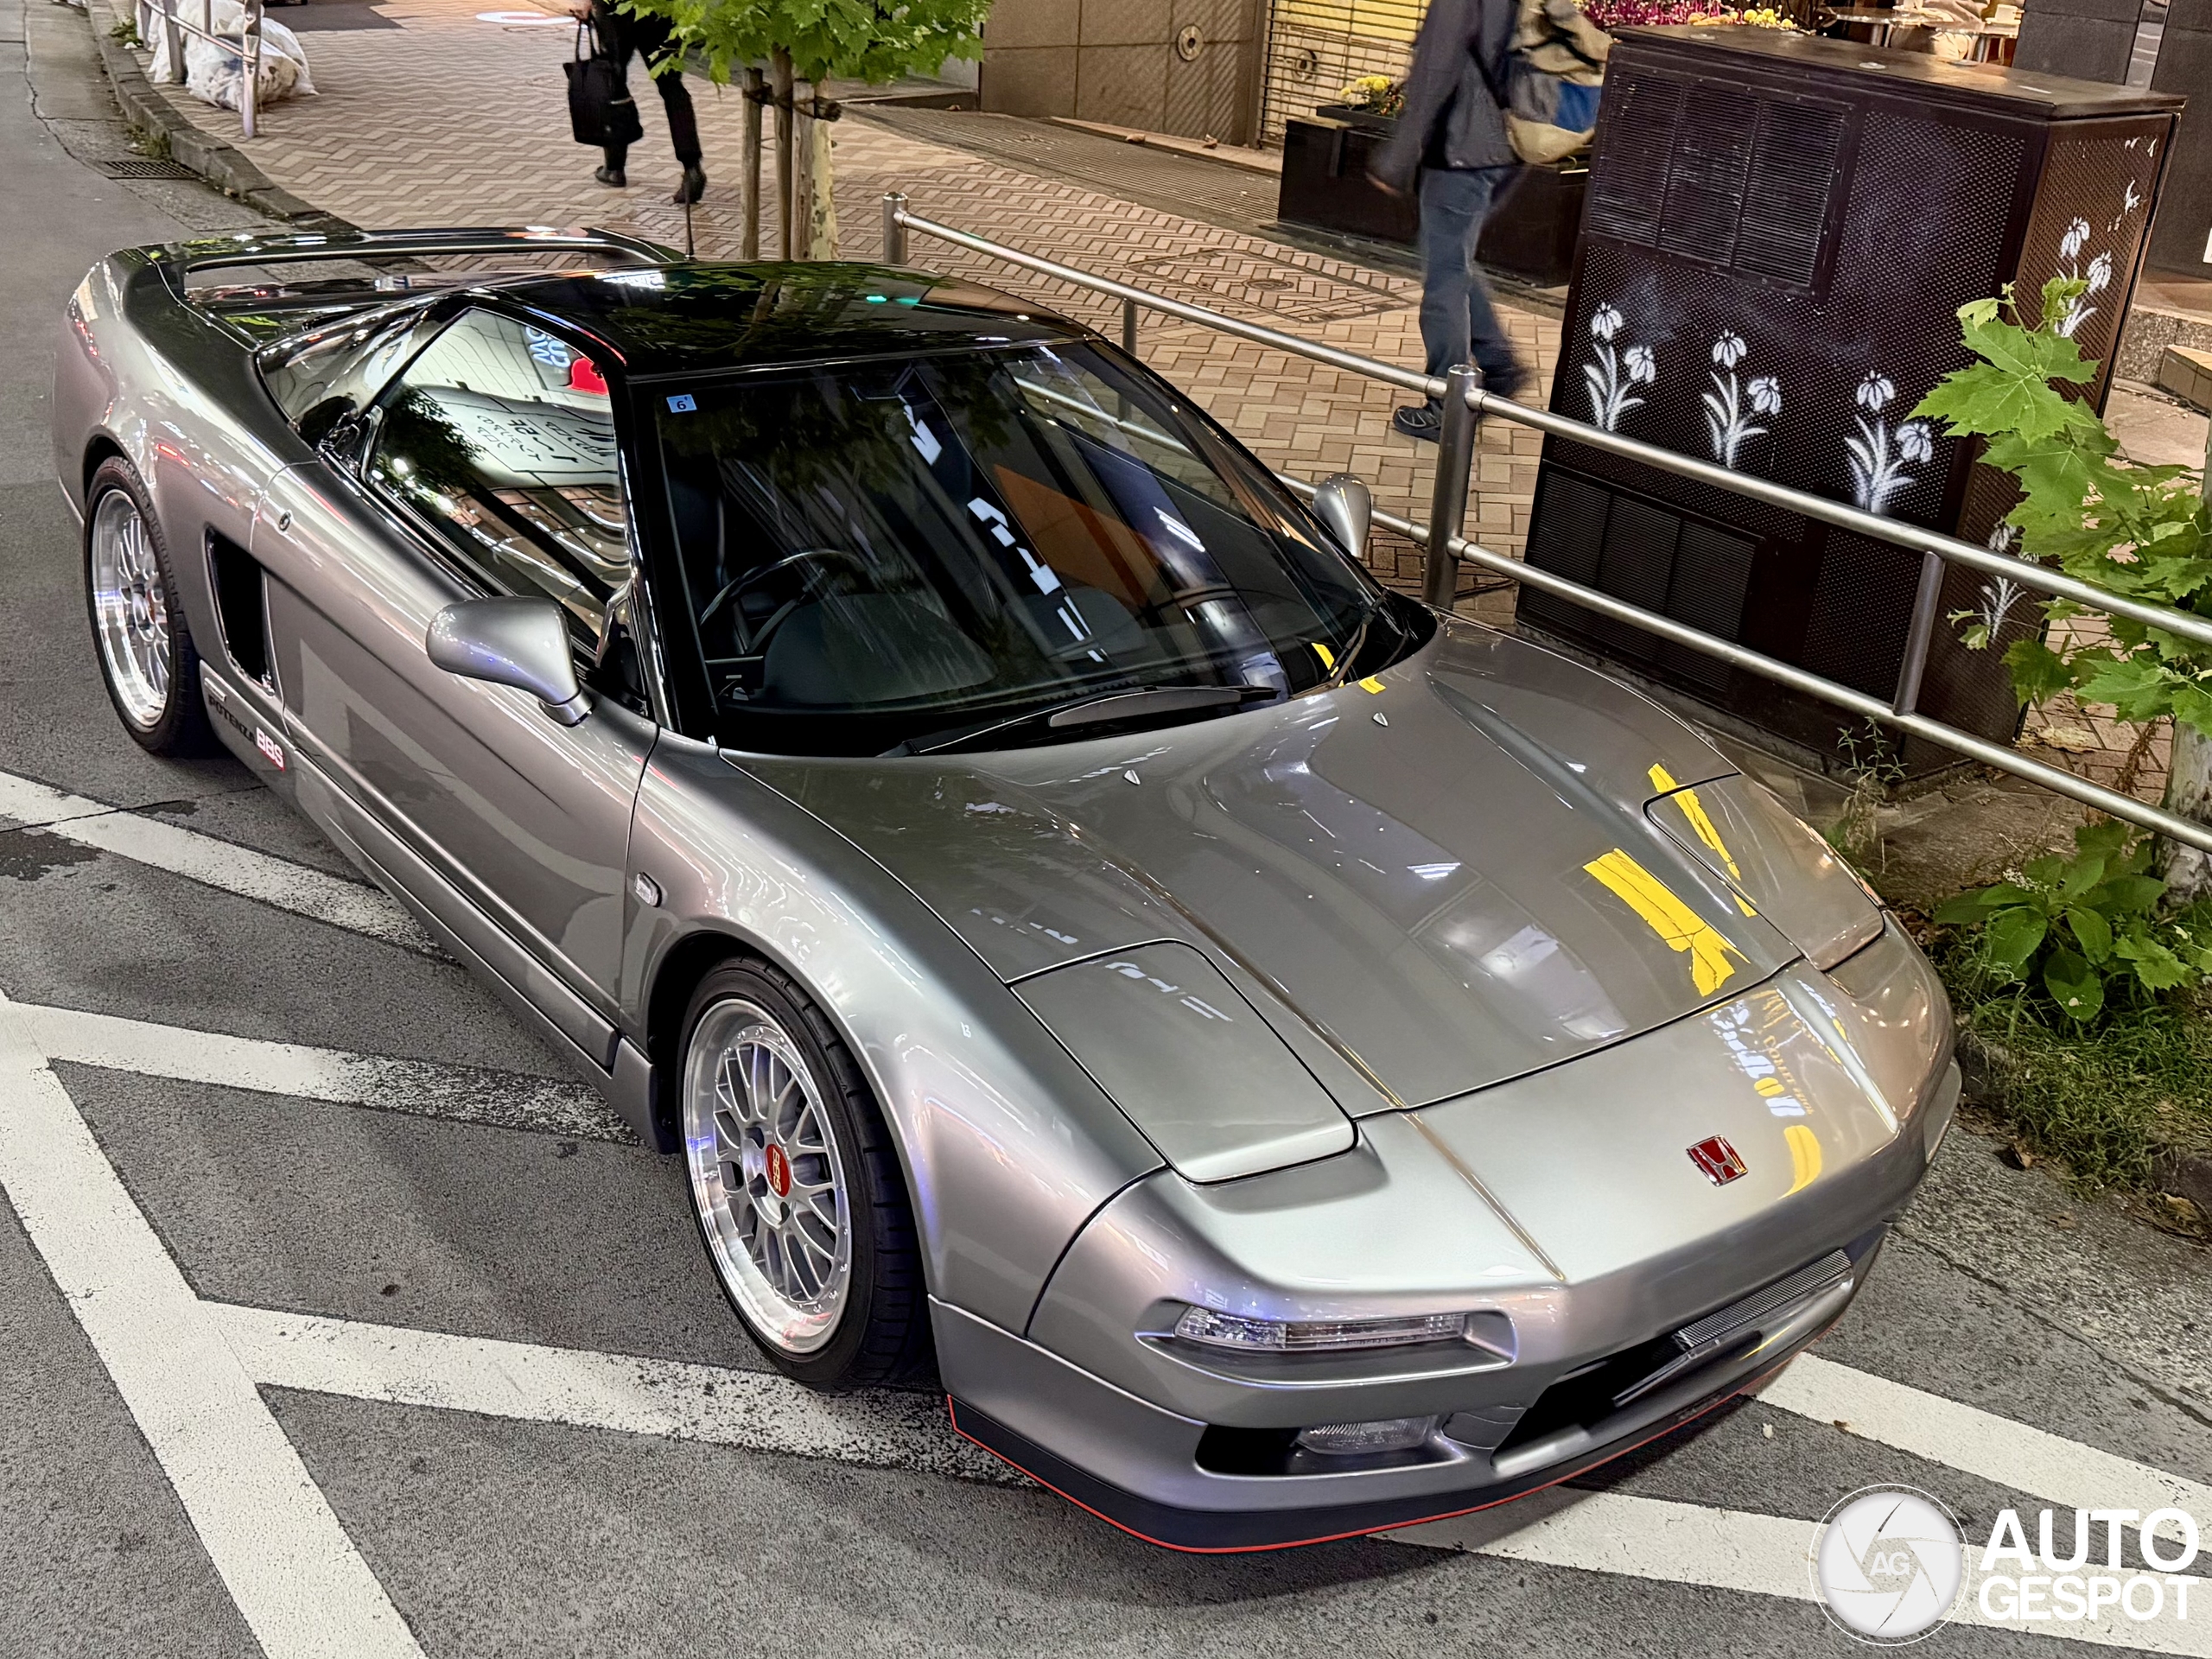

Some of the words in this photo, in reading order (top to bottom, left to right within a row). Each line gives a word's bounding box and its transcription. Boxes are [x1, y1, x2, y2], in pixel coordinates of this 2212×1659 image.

[208, 694, 257, 747] POTENZA
[256, 727, 285, 770] BBS
[772, 1147, 782, 1192] BBS
